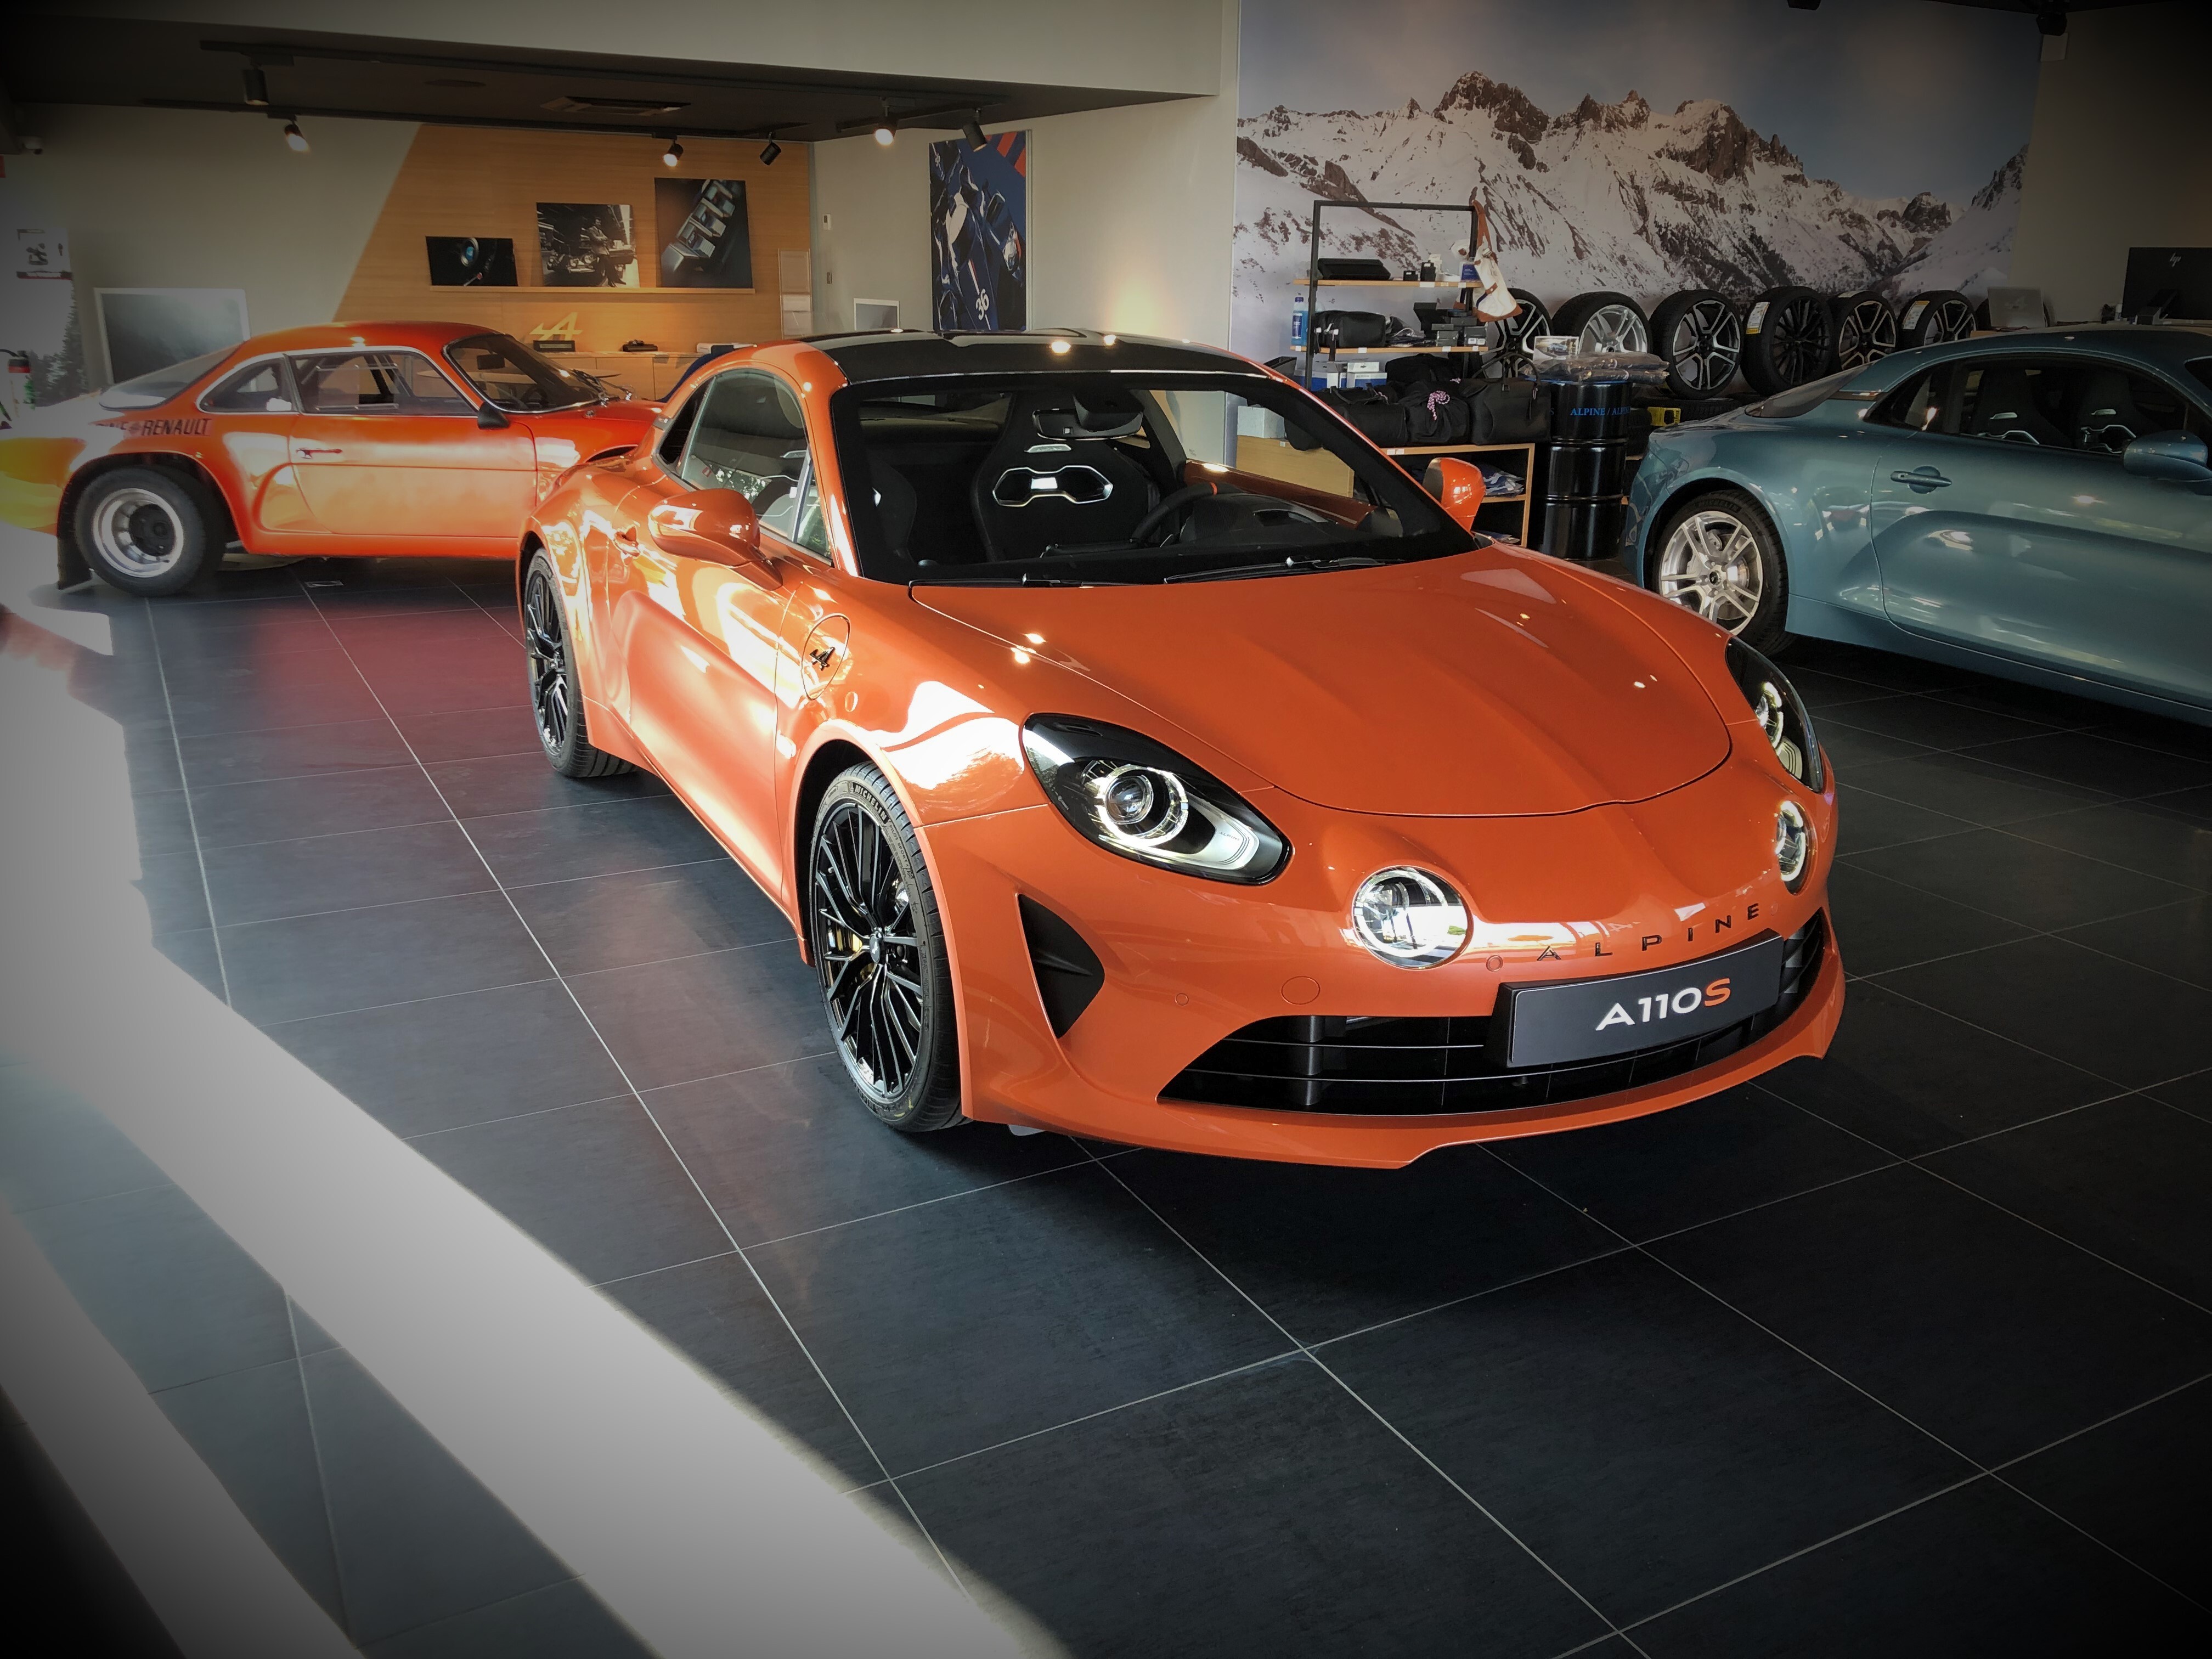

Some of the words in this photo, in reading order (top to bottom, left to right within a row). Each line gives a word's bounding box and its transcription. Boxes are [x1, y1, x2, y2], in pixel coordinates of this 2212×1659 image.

[975, 288, 990, 321] 36
[141, 419, 212, 436] RENAULT
[1570, 407, 1606, 416] ALPINE
[855, 785, 888, 821] MICHELIN
[1536, 902, 1759, 961] ALPINE
[1595, 978, 1731, 1031] A110S
